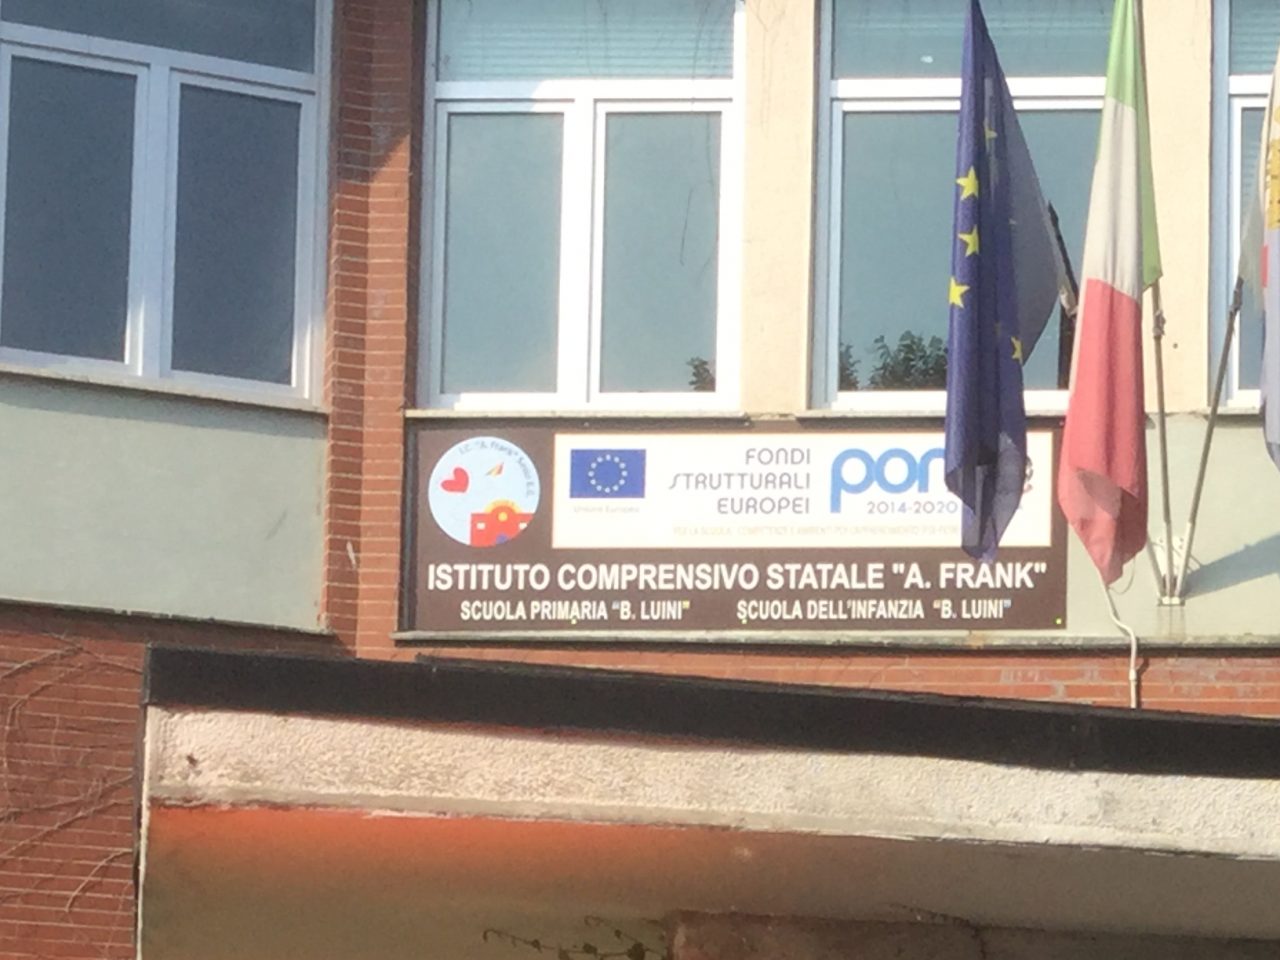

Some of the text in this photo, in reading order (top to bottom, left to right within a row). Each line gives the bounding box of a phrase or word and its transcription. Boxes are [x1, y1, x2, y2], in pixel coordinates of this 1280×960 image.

[745, 447, 811, 465] FONDI
[668, 472, 811, 490] STRUTTURALI
[717, 497, 809, 514] EUROPEI
[867, 501, 958, 514] 2014-2020
[427, 562, 1047, 591] ISTITUTO COMPRENSIVO STATALE "A. FRANK"
[460, 600, 527, 621] SCUOLA
[530, 600, 608, 620] PRIMARIA
[737, 599, 802, 619] SCUOLA
[807, 599, 925, 619] DELL'INFANZIA
